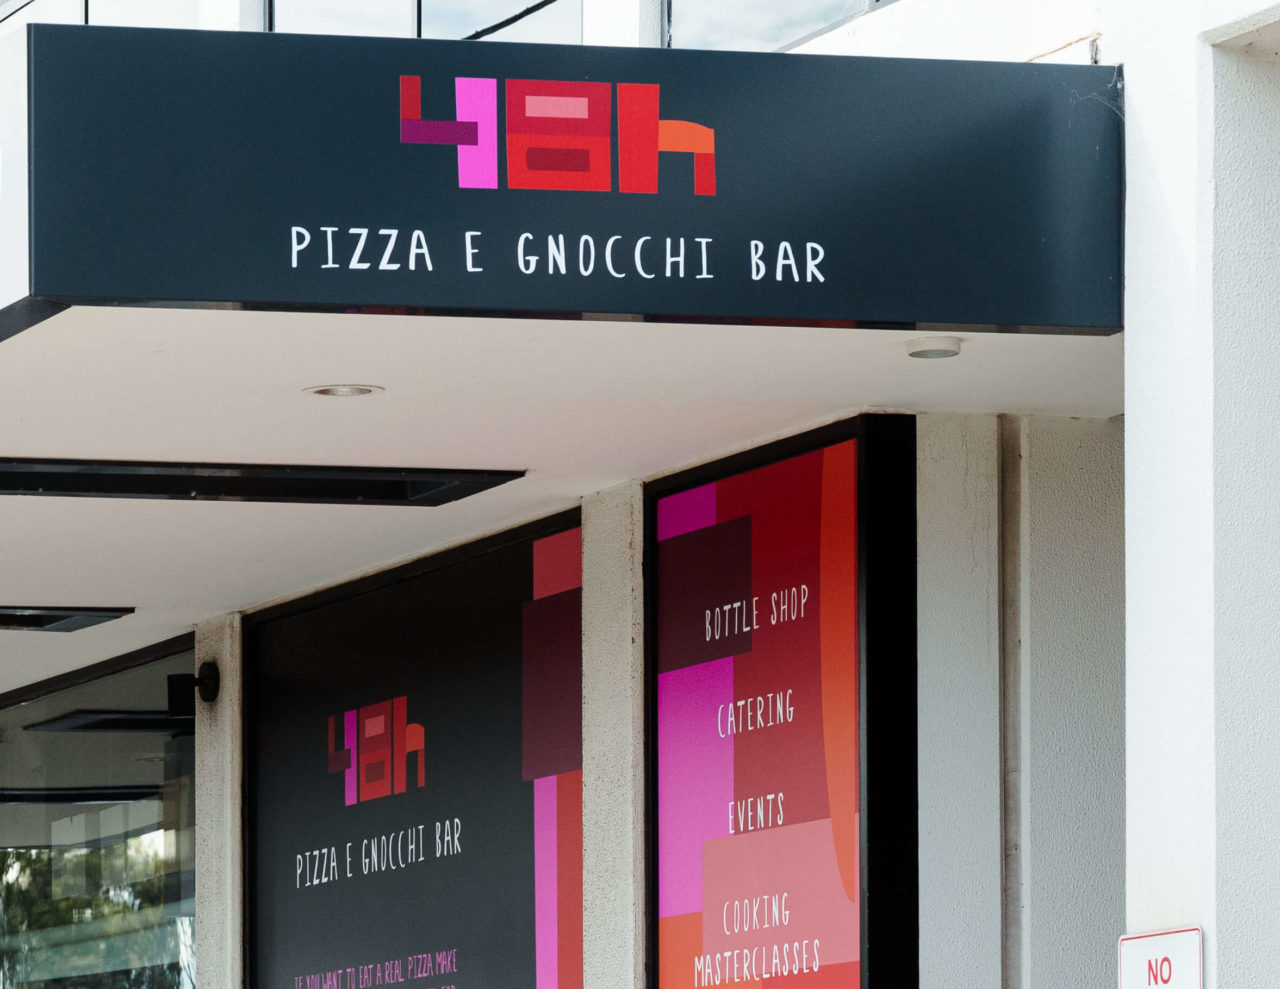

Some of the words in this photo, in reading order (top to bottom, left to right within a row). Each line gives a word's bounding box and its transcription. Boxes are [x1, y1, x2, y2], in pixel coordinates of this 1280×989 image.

[400, 75, 716, 196] 48h
[291, 226, 433, 271] PIZZA
[465, 231, 483, 272] E
[517, 233, 714, 279] GNOCCHI
[750, 240, 825, 283] BAR
[705, 597, 759, 642] BOTTLE
[770, 584, 808, 625] SHOP
[718, 689, 794, 738] CATERING
[328, 695, 425, 806] 48h
[728, 792, 784, 834] EVENTS
[296, 846, 338, 889] PIZZA
[346, 843, 352, 878] E
[362, 825, 424, 875] GNOCCHI
[436, 818, 461, 858] BAR
[723, 892, 790, 935] COOKING
[359, 963, 373, 989] EAT
[376, 962, 382, 986] A
[384, 958, 404, 984] REAL
[408, 953, 433, 981] PIZZA
[435, 949, 457, 976] MAKE
[694, 939, 820, 988] MASTERCLASSES
[1148, 956, 1171, 986] NO
